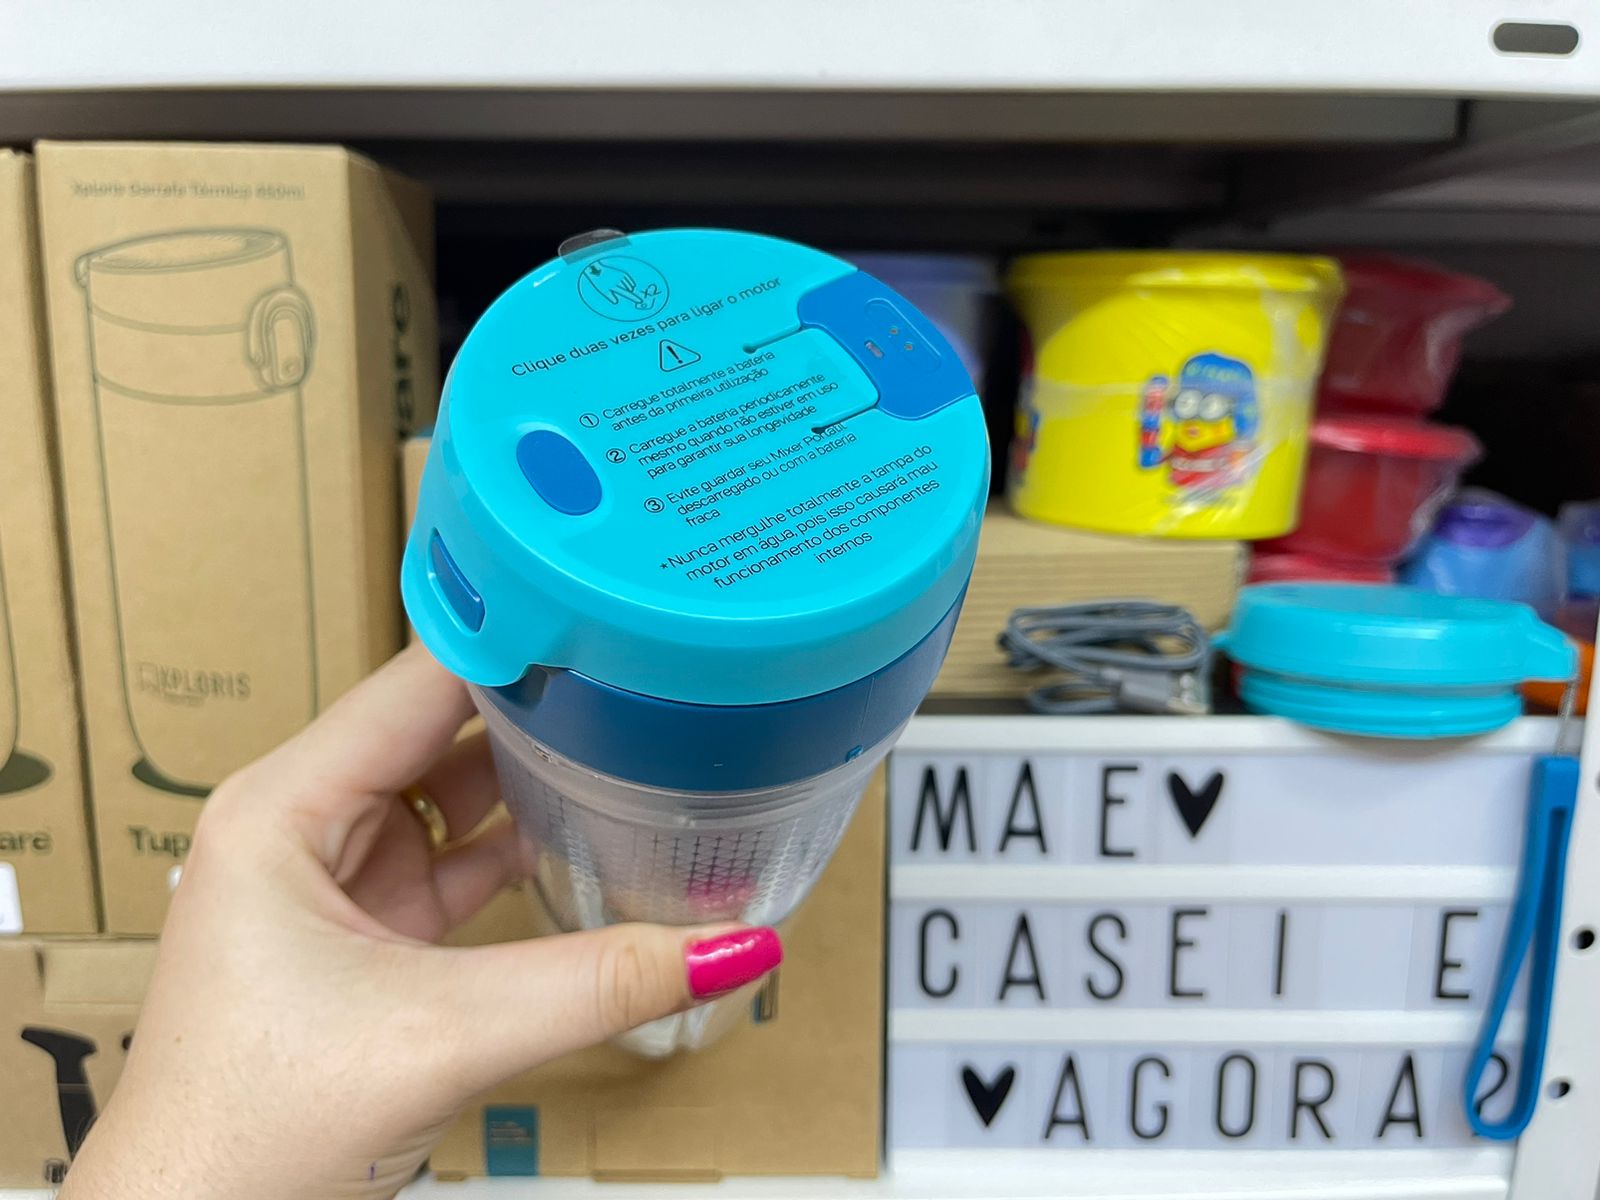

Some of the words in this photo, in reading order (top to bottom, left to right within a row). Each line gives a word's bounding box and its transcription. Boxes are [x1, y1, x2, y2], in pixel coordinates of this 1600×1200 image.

[511, 353, 567, 376] Clique
[569, 340, 609, 359] duas
[609, 323, 656, 345] vezes
[656, 311, 691, 332] para
[690, 299, 725, 317] ligar
[727, 295, 738, 305] o
[738, 277, 782, 301] motor
[602, 393, 661, 420] Carregue
[660, 369, 726, 399] totalmente
[727, 366, 736, 376] a
[734, 350, 776, 372] bateria
[611, 413, 648, 432] antes
[648, 404, 666, 419] da
[665, 388, 715, 414] primeira
[714, 366, 769, 393] utilização
[628, 424, 688, 454] Carregue
[688, 423, 698, 433] a
[698, 407, 739, 428] bateria
[738, 373, 826, 416] periodicamente
[638, 443, 688, 466] mesmo
[688, 424, 734, 448] quando
[734, 413, 758, 428] não
[758, 399, 797, 419] estiver
[796, 390, 817, 404] em
[817, 381, 839, 396] uso
[646, 462, 677, 480] para
[680, 441, 724, 469] garantir
[723, 432, 748, 449] sua
[746, 404, 818, 438] longevidade
[666, 483, 700, 505] Evite
[701, 465, 746, 493] guardar
[747, 455, 771, 470] seu
[770, 440, 804, 464] Mixer
[677, 475, 762, 516] descarregado
[762, 466, 779, 481] ou
[779, 455, 808, 473] com
[808, 449, 817, 461] a
[818, 433, 857, 456] bateria
[685, 508, 721, 528] fraca
[686, 554, 731, 581] motor
[733, 545, 759, 562] em
[758, 529, 798, 553] água,
[796, 514, 827, 538] pois
[826, 501, 856, 521] isso
[856, 475, 908, 506] causará
[908, 461, 938, 482] mau
[713, 535, 823, 589] funcionamento
[822, 521, 850, 541] dos
[850, 479, 940, 528] componentes
[718, 510, 787, 549] mergulhe
[786, 479, 861, 516] totalmente
[861, 473, 871, 484] a
[870, 454, 914, 480] tampa
[914, 444, 932, 459] do
[814, 531, 873, 565] internos
[0, 830, 53, 854] are
[127, 825, 191, 857] Tup
[917, 908, 1288, 1001] CASEI
[1434, 909, 1479, 1000] E
